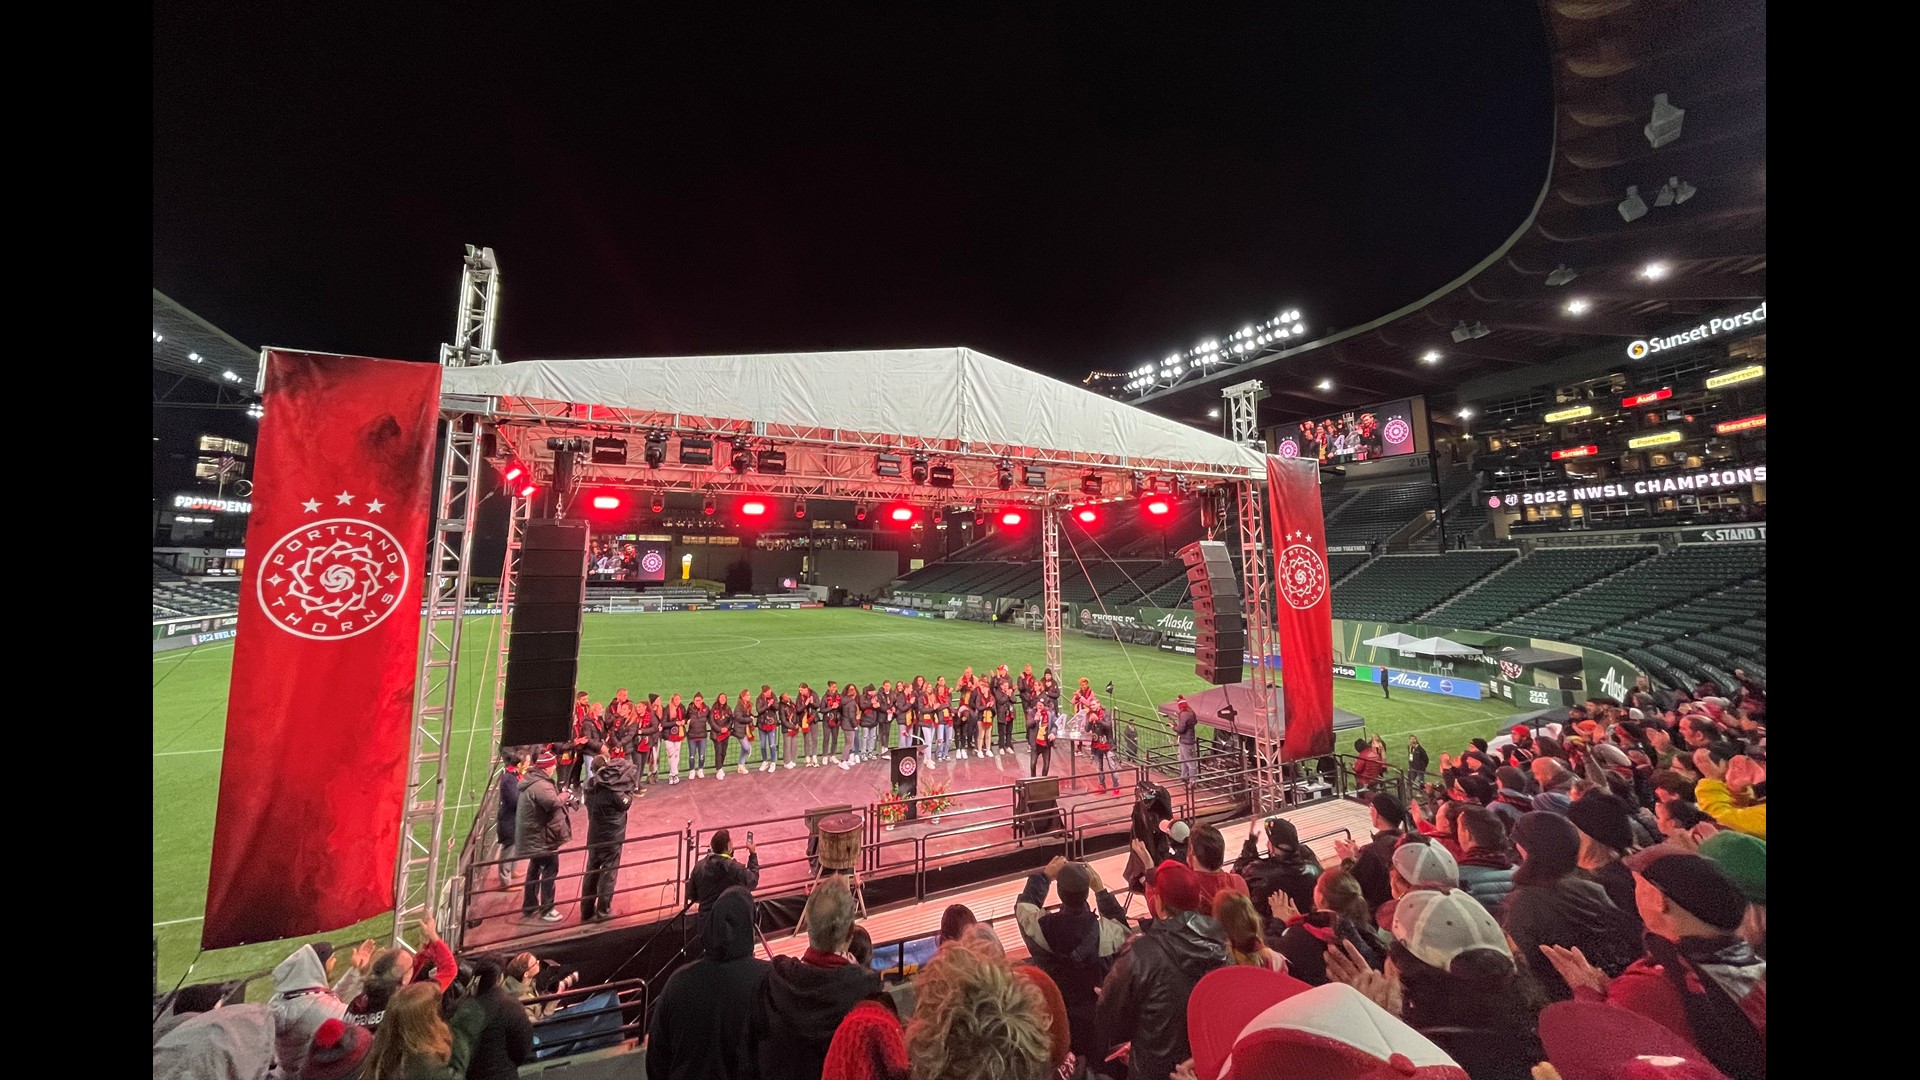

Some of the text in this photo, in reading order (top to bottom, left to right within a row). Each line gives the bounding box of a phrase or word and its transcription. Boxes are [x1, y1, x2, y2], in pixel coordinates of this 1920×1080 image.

[1650, 324, 1709, 353] Sunset
[1709, 369, 1760, 386] Beaverton
[1636, 393, 1657, 404] Audi
[1637, 436, 1672, 446] Porsche
[1409, 458, 1428, 468] 216
[1523, 490, 1567, 505] 2022
[1573, 483, 1628, 501] NWSL
[1634, 466, 1766, 494] CHAMPIONS
[1715, 528, 1756, 541] STAND
[273, 525, 398, 565] PORTLAND
[271, 592, 394, 633] THORNS
[1157, 613, 1194, 631] Alaska
[1529, 690, 1548, 698] SEAT
[1529, 696, 1550, 706] GEEK
